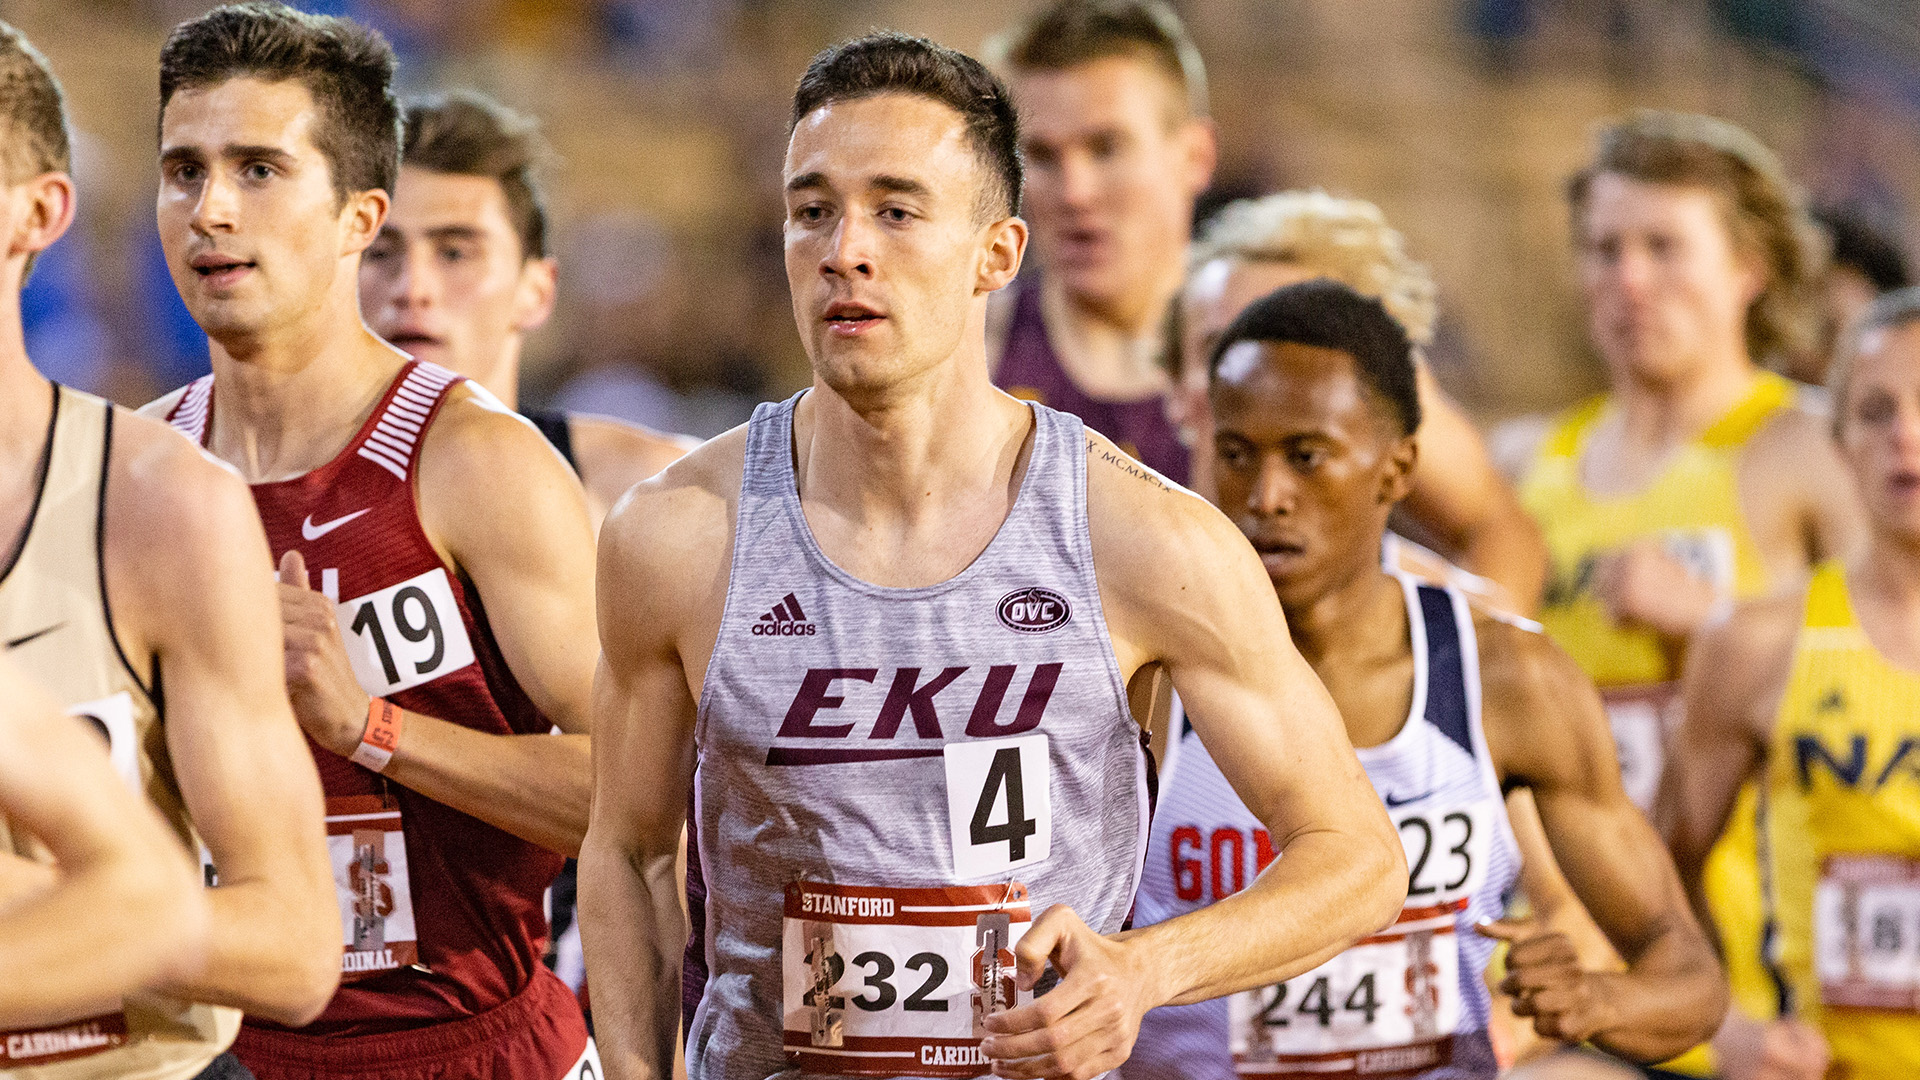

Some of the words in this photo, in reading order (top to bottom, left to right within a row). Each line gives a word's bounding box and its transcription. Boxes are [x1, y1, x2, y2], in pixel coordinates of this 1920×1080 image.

[350, 585, 445, 686] 19
[751, 620, 817, 637] adidas
[1011, 602, 1056, 622] OVC
[774, 661, 1065, 741] EKU
[968, 746, 1037, 863] 4
[1399, 811, 1474, 897] 23
[802, 892, 895, 918] STANFORD
[343, 949, 399, 972] DINAL
[802, 951, 950, 1013] 232
[1262, 972, 1382, 1028] 244
[921, 1045, 990, 1066] CARDIN
